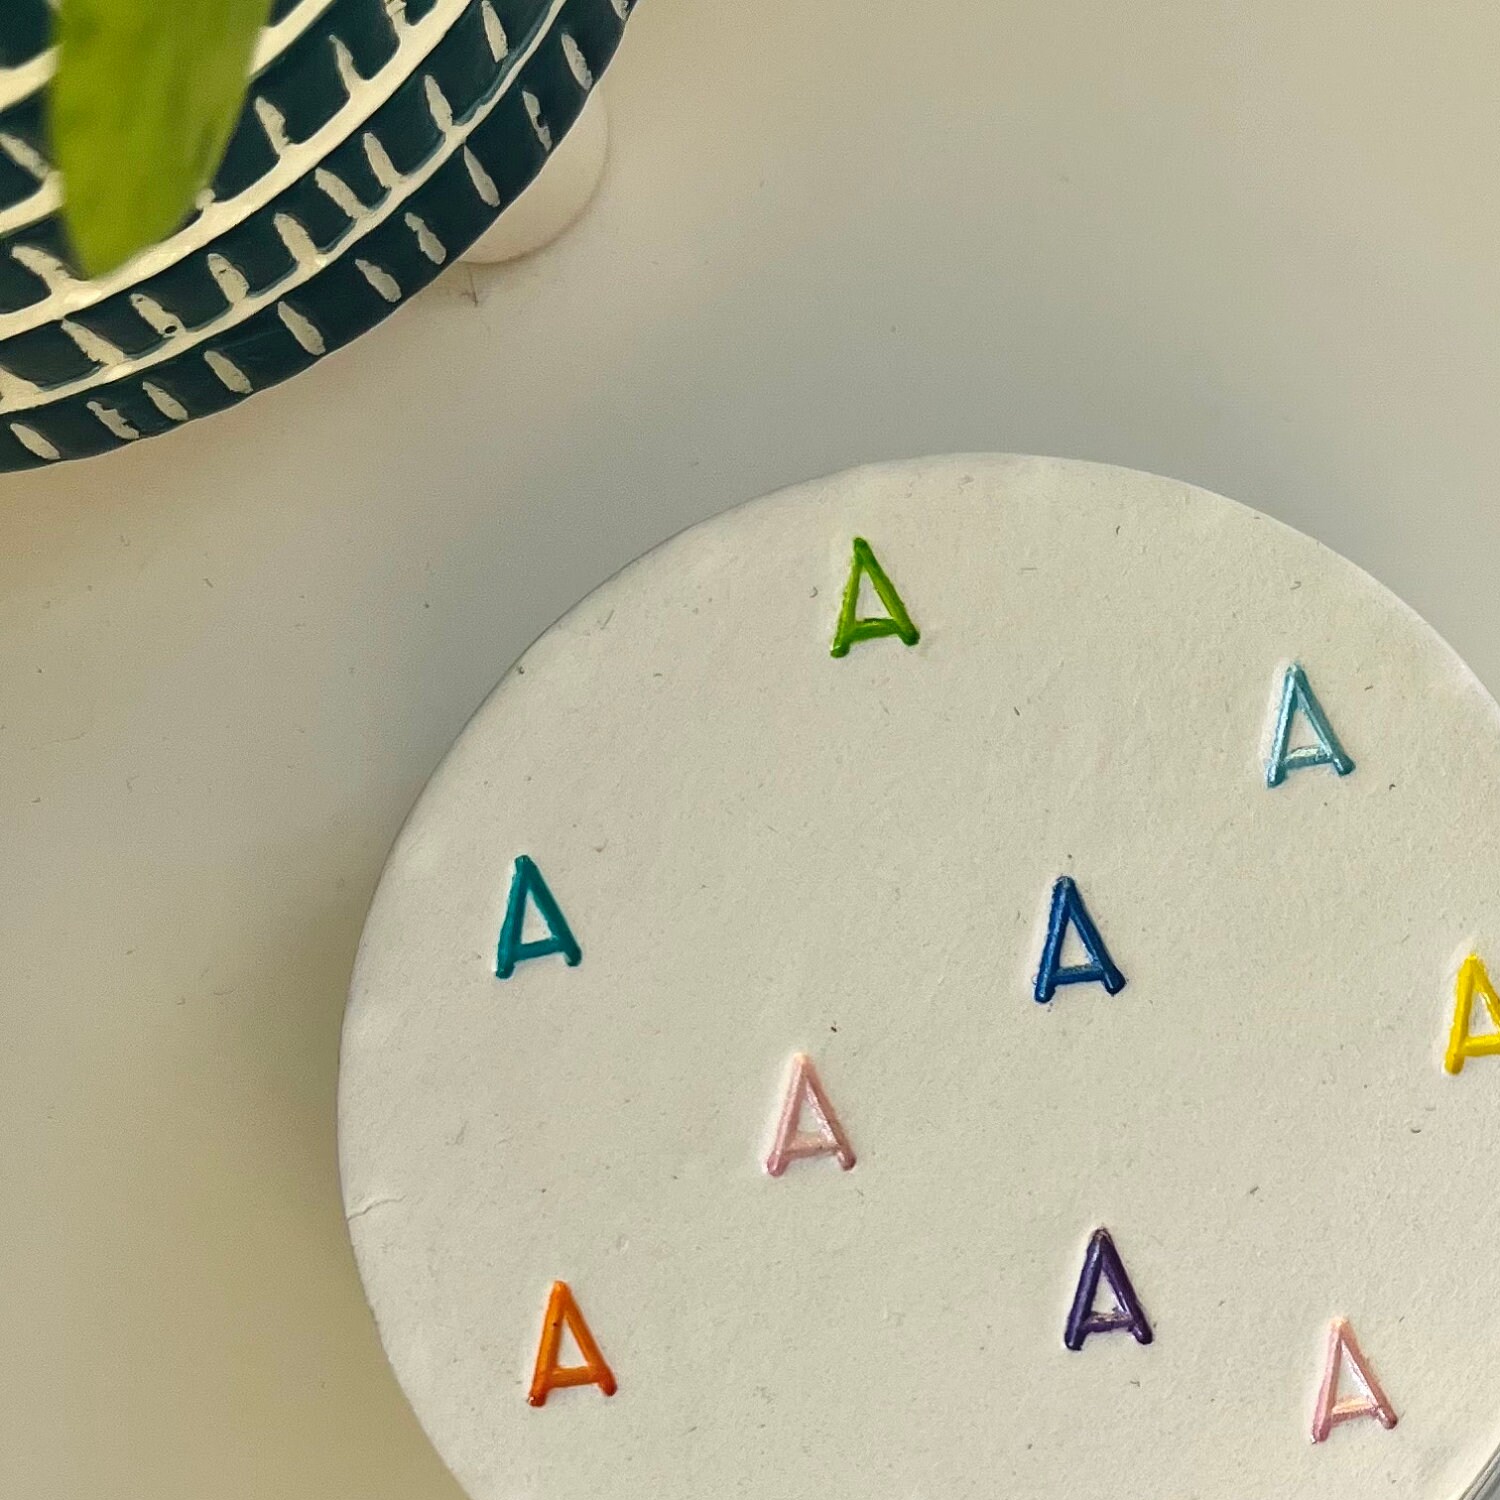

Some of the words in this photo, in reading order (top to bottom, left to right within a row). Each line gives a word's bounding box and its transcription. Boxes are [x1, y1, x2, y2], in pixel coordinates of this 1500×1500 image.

[831, 538, 918, 657] A
[1264, 664, 1354, 788] A
[495, 856, 581, 979] A
[1033, 878, 1125, 1003] A
[761, 1055, 856, 1177] A
[530, 1283, 615, 1405] A
[1064, 1230, 1152, 1350] A
[1311, 1320, 1397, 1443] A
